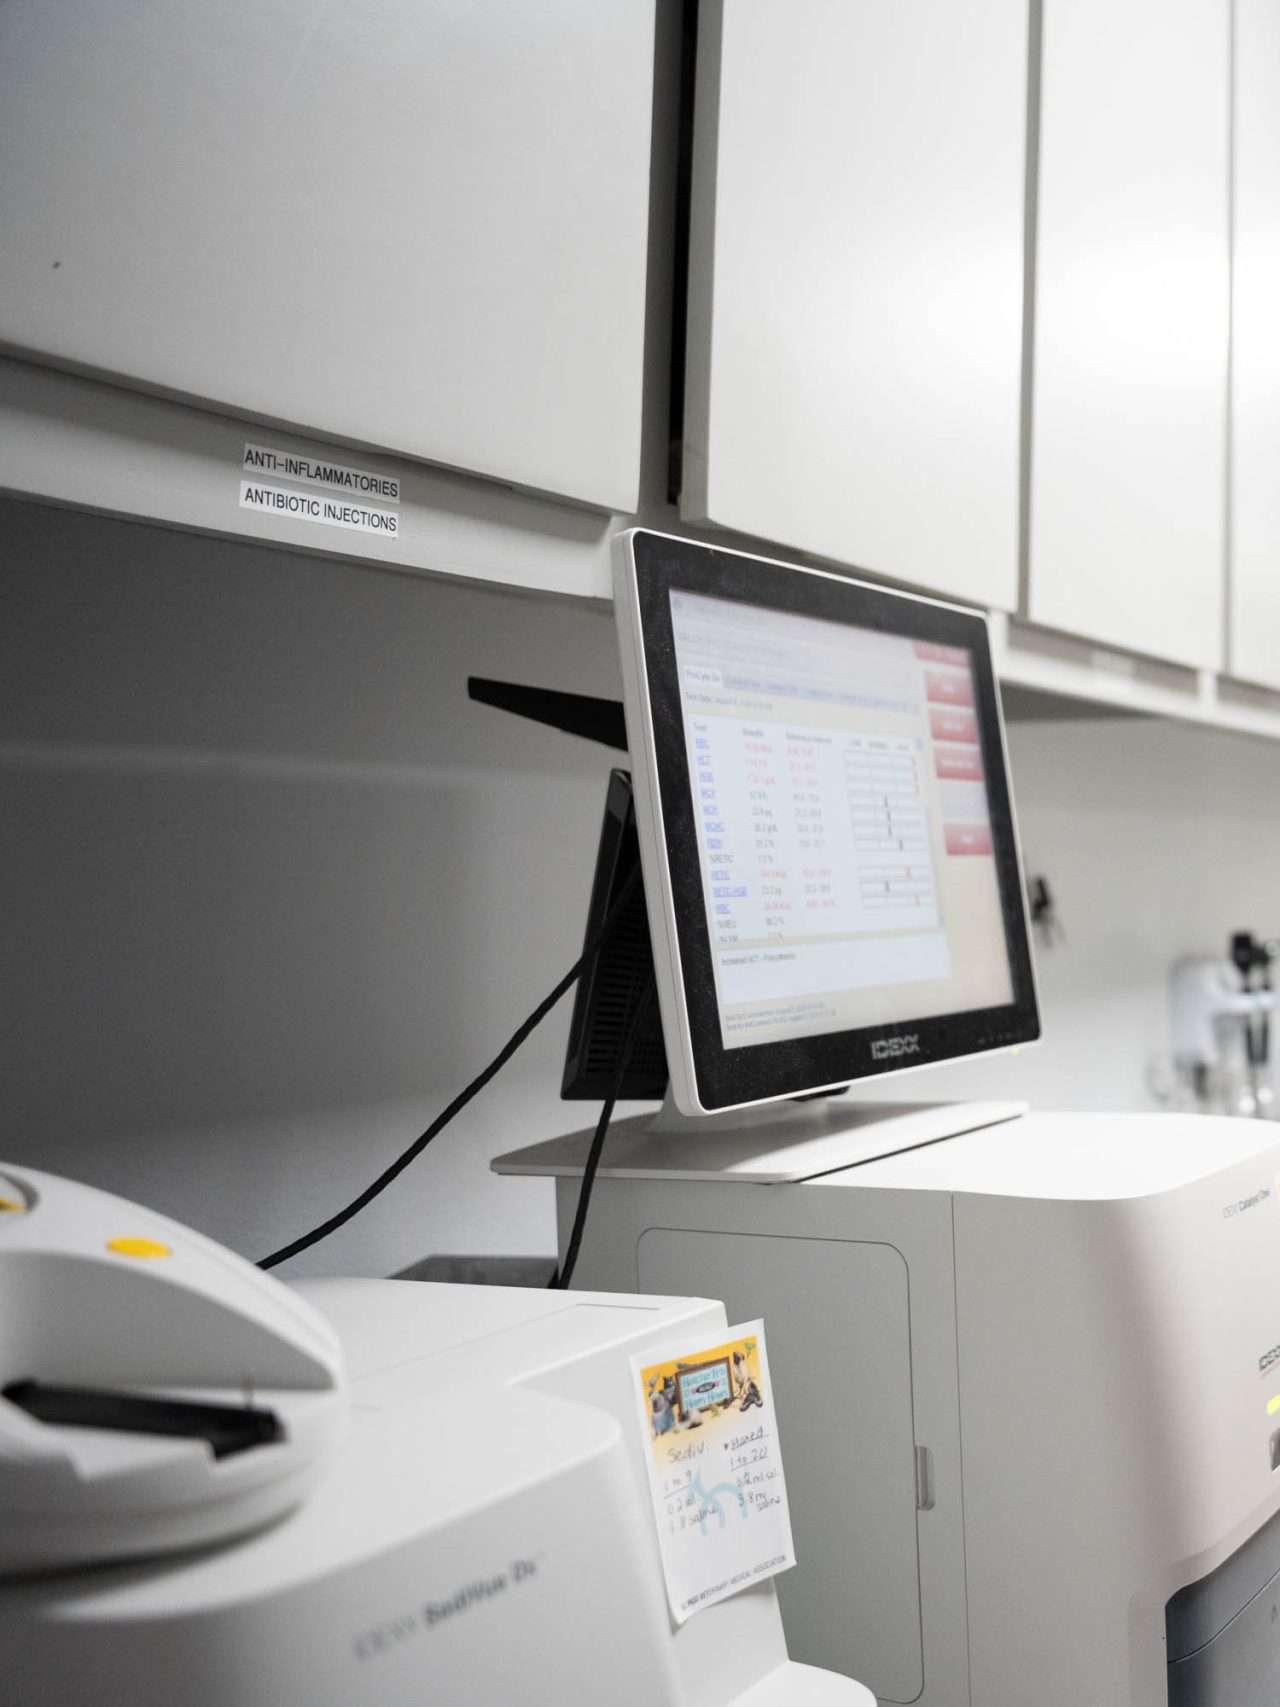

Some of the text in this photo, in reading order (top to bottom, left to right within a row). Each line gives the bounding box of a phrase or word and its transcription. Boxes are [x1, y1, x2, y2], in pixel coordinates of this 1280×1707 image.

[245, 449, 398, 497] ANTI-INFLAMMATORIES
[244, 487, 397, 532] ANTIBIOTIC INJECTIONS
[871, 1033, 920, 1060] IDEXX
